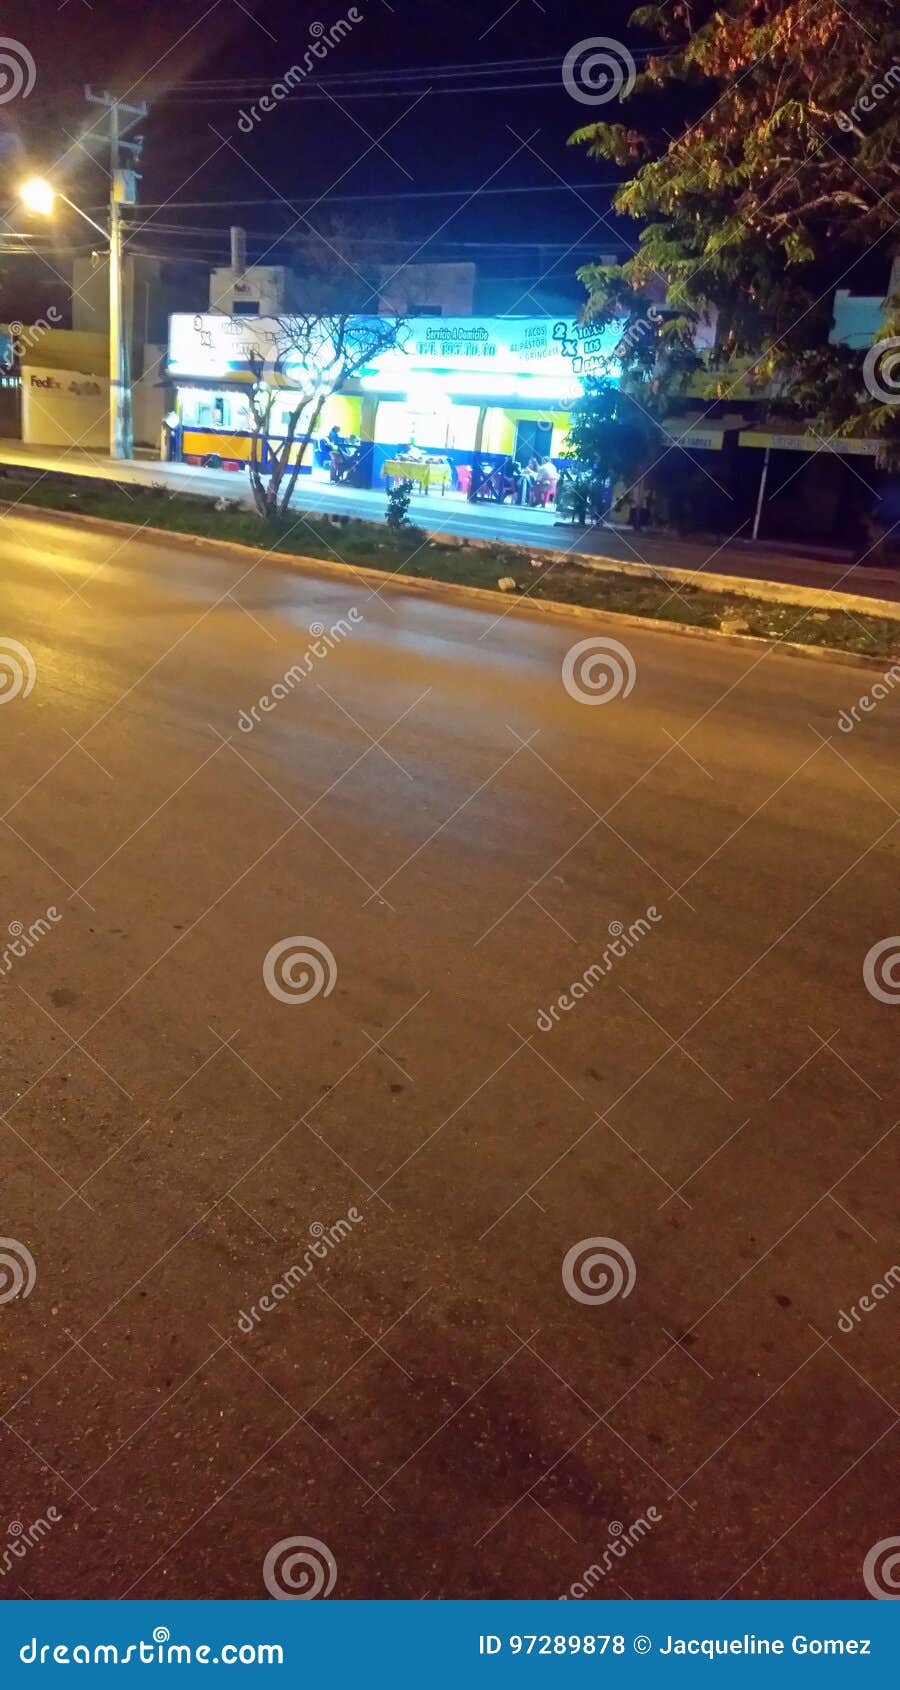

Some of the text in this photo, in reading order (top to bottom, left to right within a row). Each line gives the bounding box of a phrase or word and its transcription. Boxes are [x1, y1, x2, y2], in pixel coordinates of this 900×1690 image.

[525, 326, 547, 338] TACOS
[552, 322, 568, 340] 2
[572, 356, 583, 373] 1
